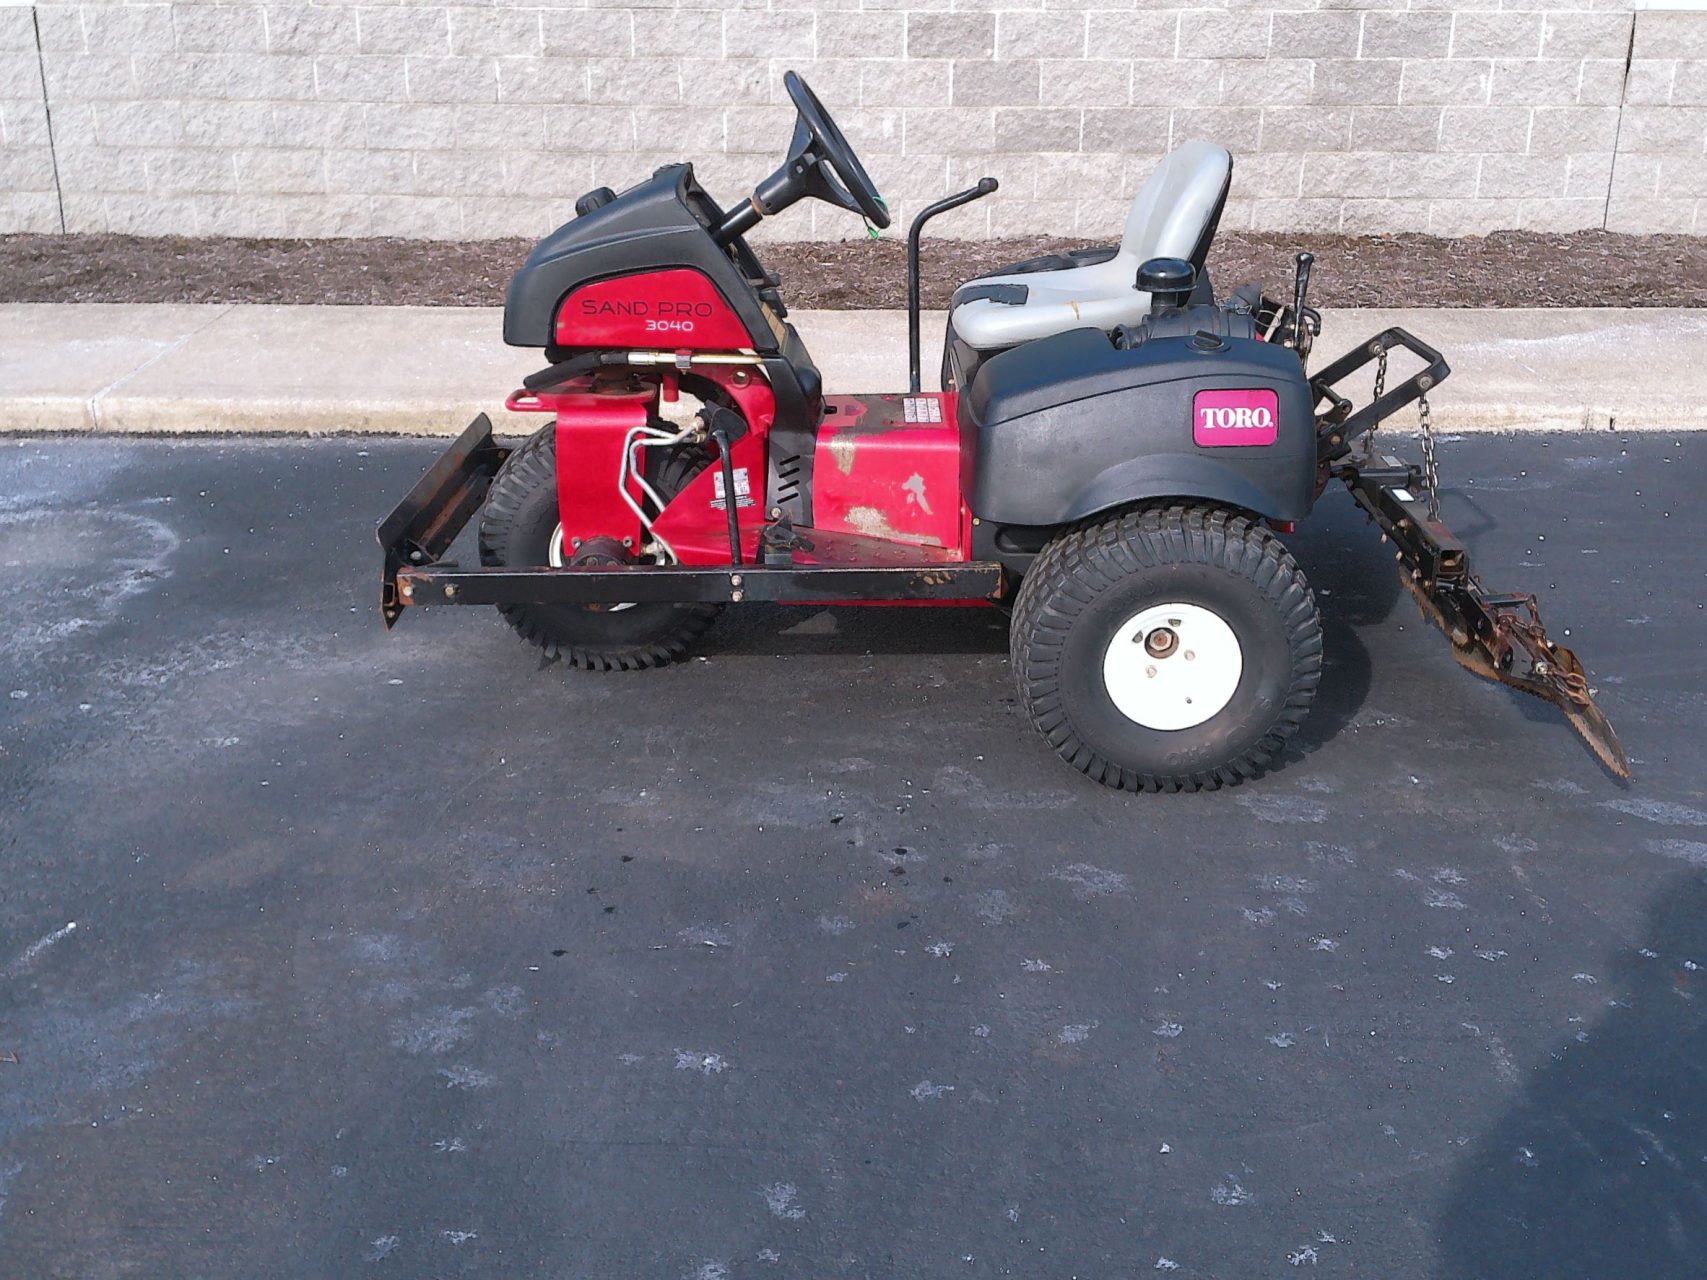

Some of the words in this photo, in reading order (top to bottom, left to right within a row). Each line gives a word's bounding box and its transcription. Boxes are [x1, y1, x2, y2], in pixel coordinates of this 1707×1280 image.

[582, 300, 649, 316] SAND
[658, 302, 713, 317] PRO
[646, 320, 693, 332] 3040
[1200, 407, 1272, 428] TORO
